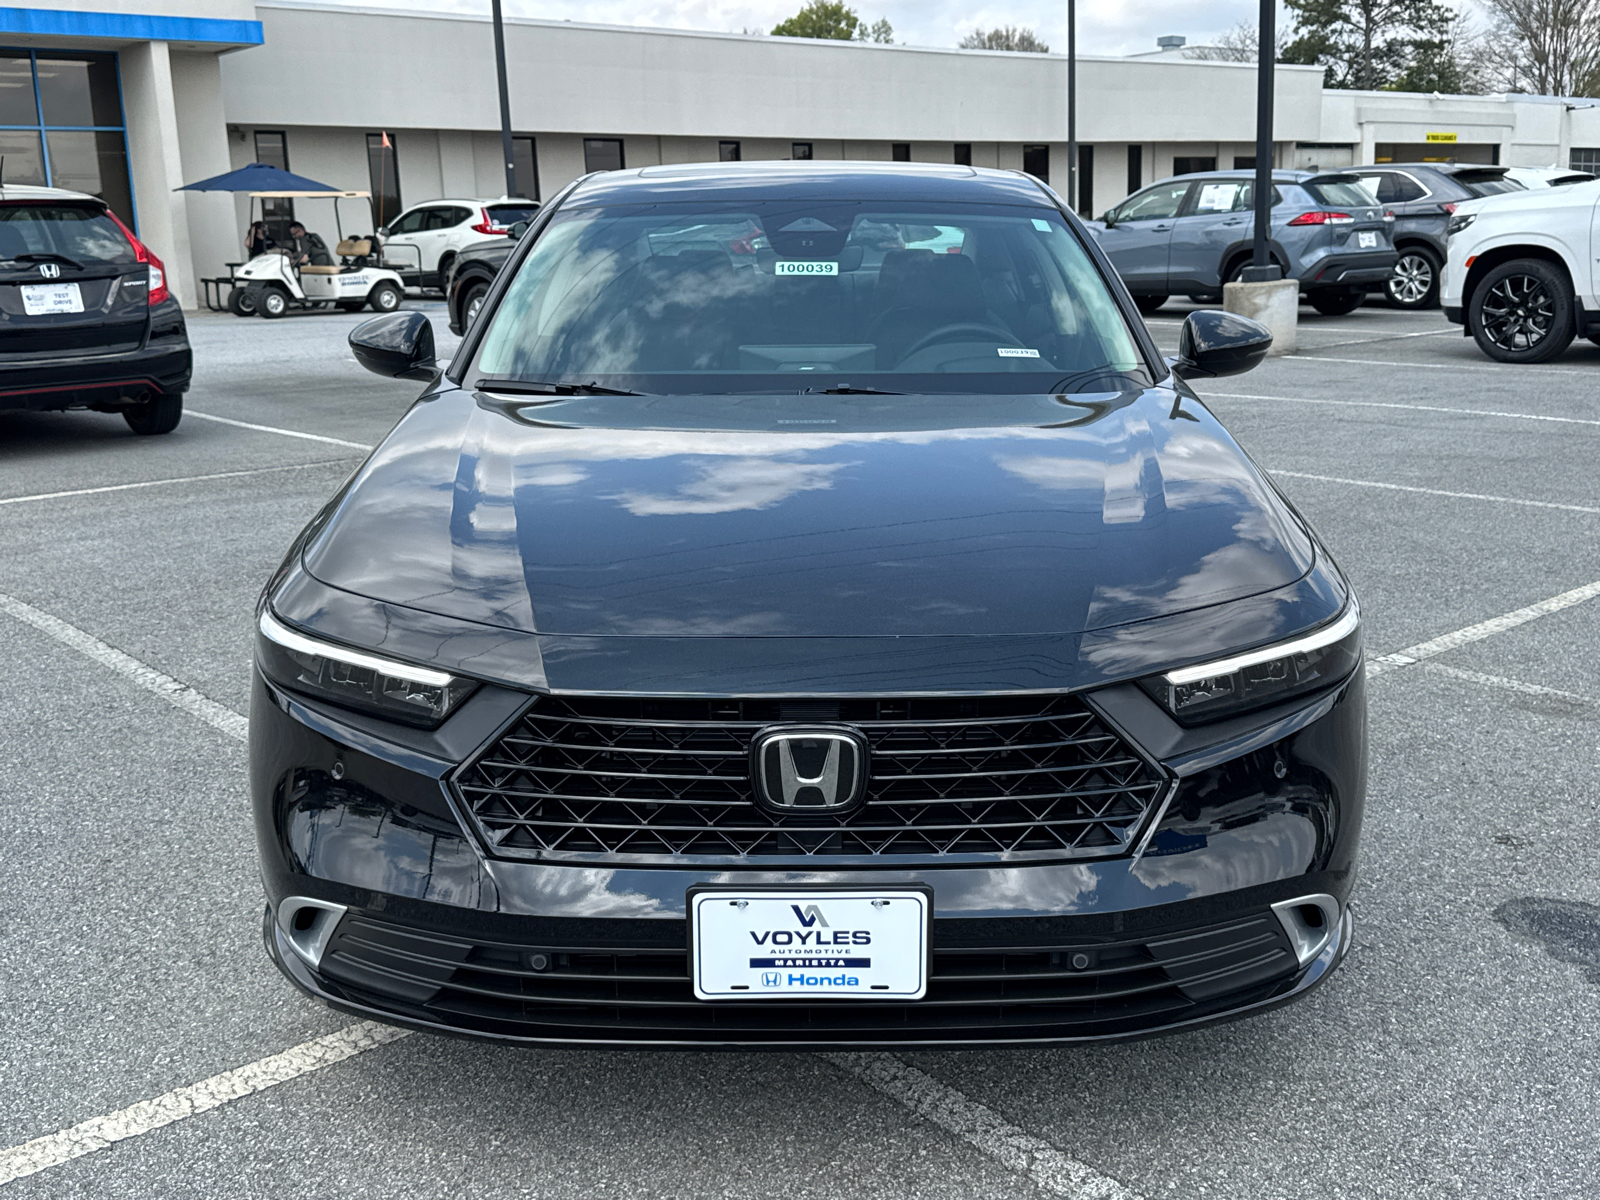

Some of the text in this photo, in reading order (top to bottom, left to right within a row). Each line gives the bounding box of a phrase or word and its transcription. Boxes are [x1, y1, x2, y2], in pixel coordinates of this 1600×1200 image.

[778, 263, 833, 273] 100039
[749, 930, 872, 946] VOYLES
[787, 973, 859, 986] Honda
